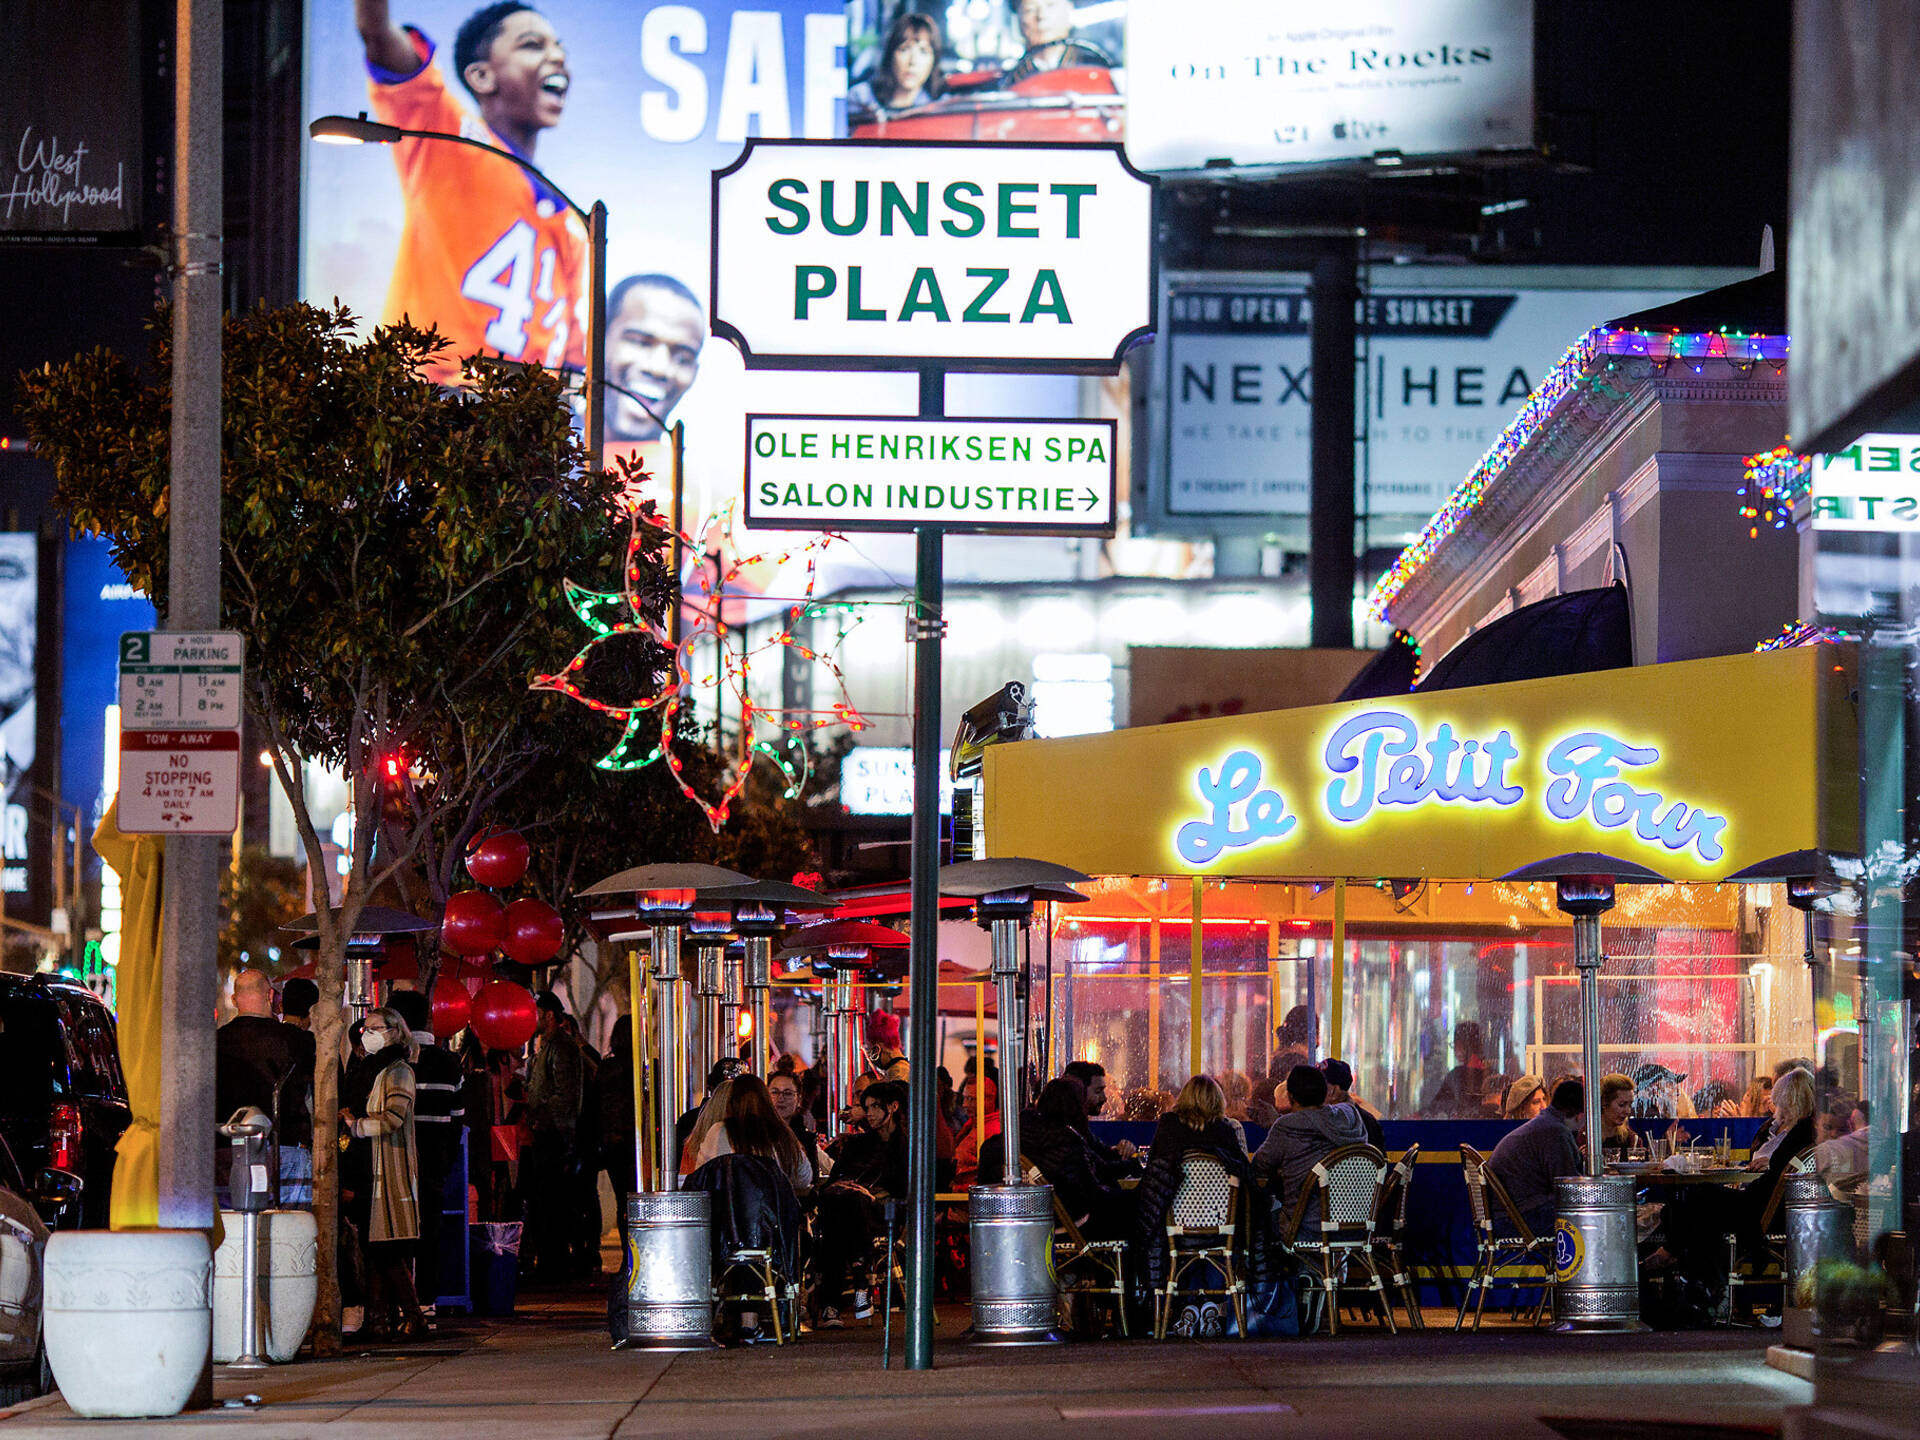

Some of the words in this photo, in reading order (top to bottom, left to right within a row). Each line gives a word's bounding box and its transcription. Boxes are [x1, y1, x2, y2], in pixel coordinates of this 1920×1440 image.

[1171, 62, 1226, 80] On
[1244, 54, 1327, 77] The
[1349, 44, 1494, 72] Rocks
[18, 125, 90, 188] West
[0, 162, 124, 224] Hollywood
[765, 178, 1097, 239] SUNSET
[794, 265, 1073, 325] PLAZA
[1230, 298, 1290, 324] OPEN
[1385, 299, 1474, 326] SUNSET
[1182, 363, 1312, 405] NEX
[755, 431, 818, 459] OLE
[831, 433, 1032, 462] HENRIKSEN
[1044, 437, 1106, 464] SPA
[759, 482, 873, 508] SALON
[886, 484, 1074, 512] INDUSTRIE
[126, 637, 143, 660] 2
[173, 648, 229, 660] PARKING
[136, 675, 145, 687] 8
[149, 679, 163, 687] AM
[197, 676, 207, 687] 11
[211, 679, 225, 687] AM
[144, 689, 156, 697] TO
[205, 689, 217, 697] TO
[136, 699, 145, 711] 2
[198, 699, 206, 711] 8
[145, 734, 168, 744] TOW
[180, 733, 213, 743] AWAY
[169, 754, 189, 768] NO
[145, 771, 212, 785] STOPPING
[142, 786, 152, 797] 4
[156, 789, 170, 797] AM
[173, 789, 184, 797] TO
[188, 786, 196, 797] 7
[200, 789, 214, 797] AM
[1177, 750, 1297, 864] Le
[1325, 711, 1525, 823] Petit
[1546, 732, 1727, 862] Four
[163, 801, 190, 809] DAILY
